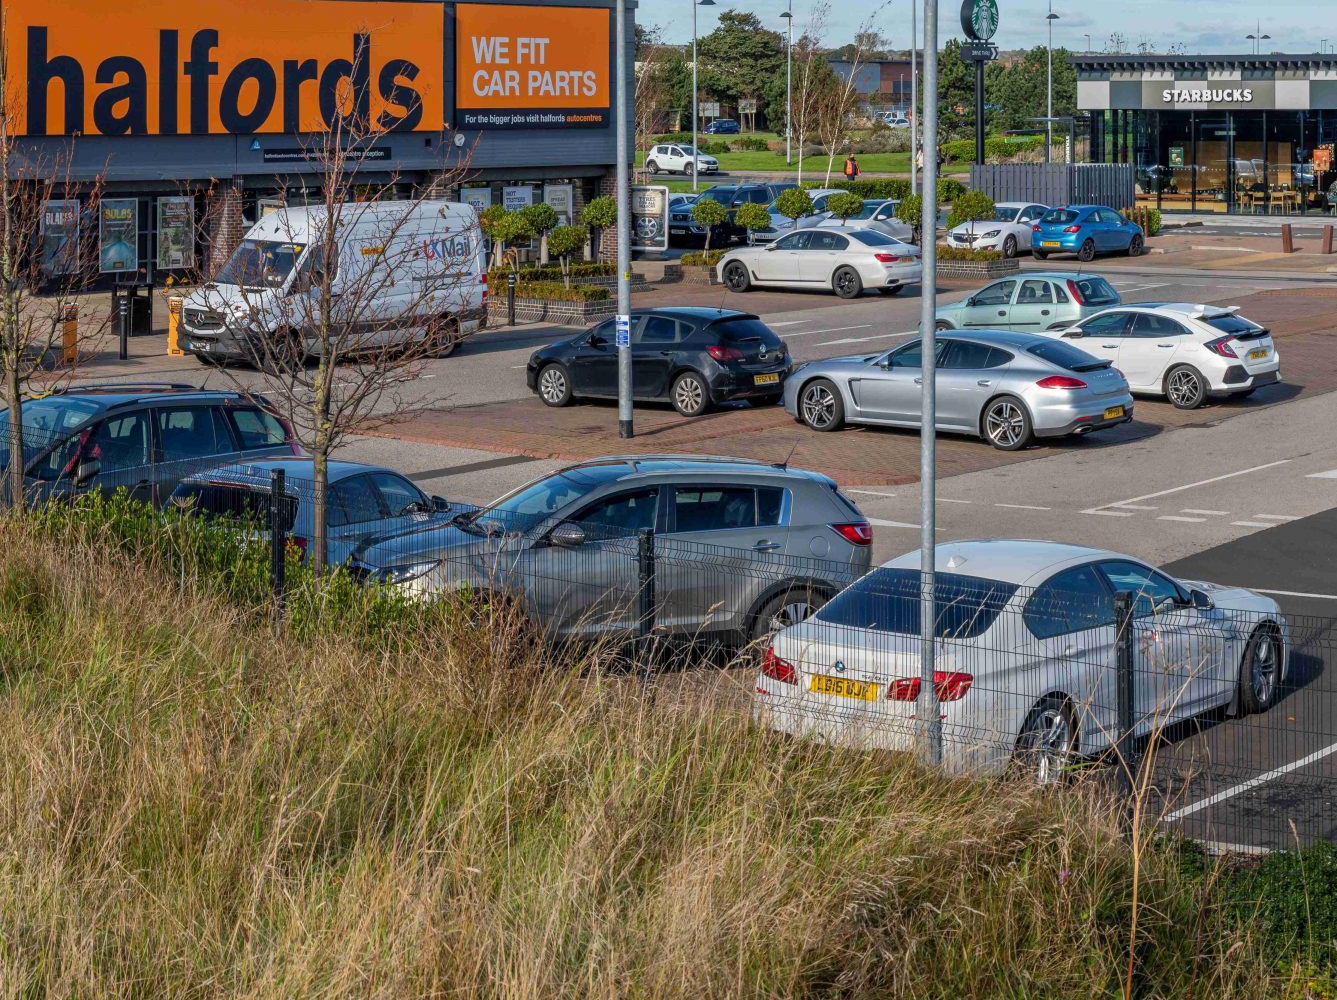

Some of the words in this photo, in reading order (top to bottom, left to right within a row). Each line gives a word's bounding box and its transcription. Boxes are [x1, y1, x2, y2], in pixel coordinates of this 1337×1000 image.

[471, 36, 510, 65] WE
[516, 37, 550, 65] FIT
[26, 26, 424, 136] halfords
[472, 69, 520, 97] CAR
[527, 70, 597, 97] PARTS
[1162, 88, 1254, 103] STARBUCKS
[465, 115, 477, 124] For
[477, 115, 489, 123] the
[489, 115, 511, 125] bigger
[511, 114, 526, 124] jobs
[526, 114, 540, 122] visit
[540, 114, 566, 122] halfords
[566, 114, 603, 122] autocentres
